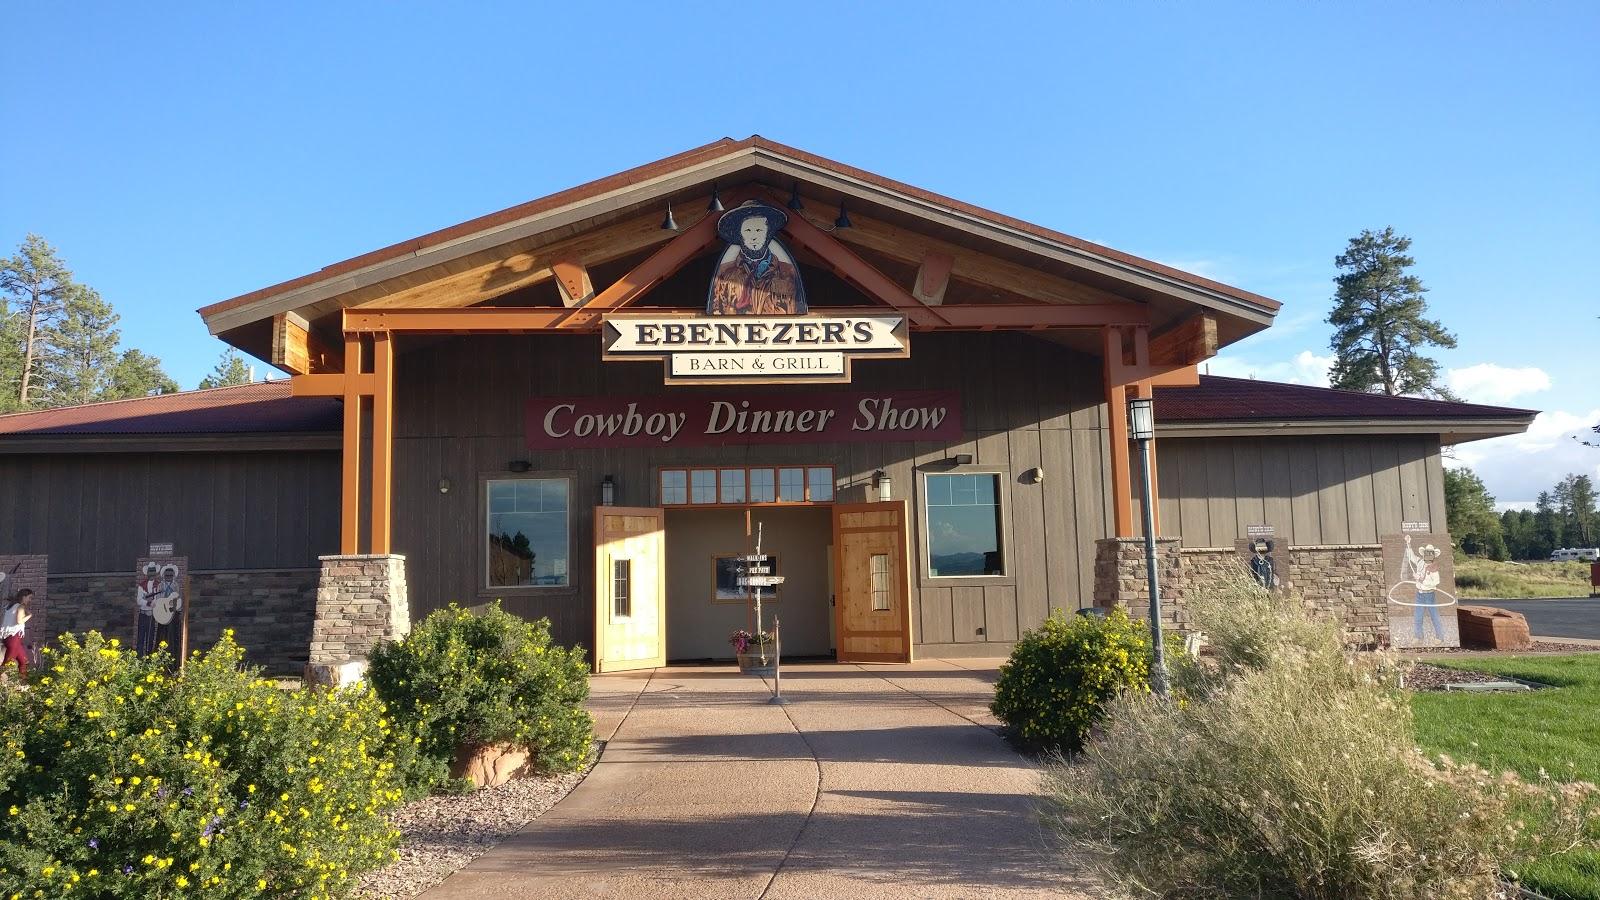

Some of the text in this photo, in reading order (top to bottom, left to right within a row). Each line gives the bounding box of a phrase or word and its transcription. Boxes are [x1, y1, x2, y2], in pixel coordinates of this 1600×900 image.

[634, 319, 875, 346] EBENEZER'S
[689, 356, 830, 371] BARN & GRILL
[543, 398, 947, 442] Cowboy Dinner Show
